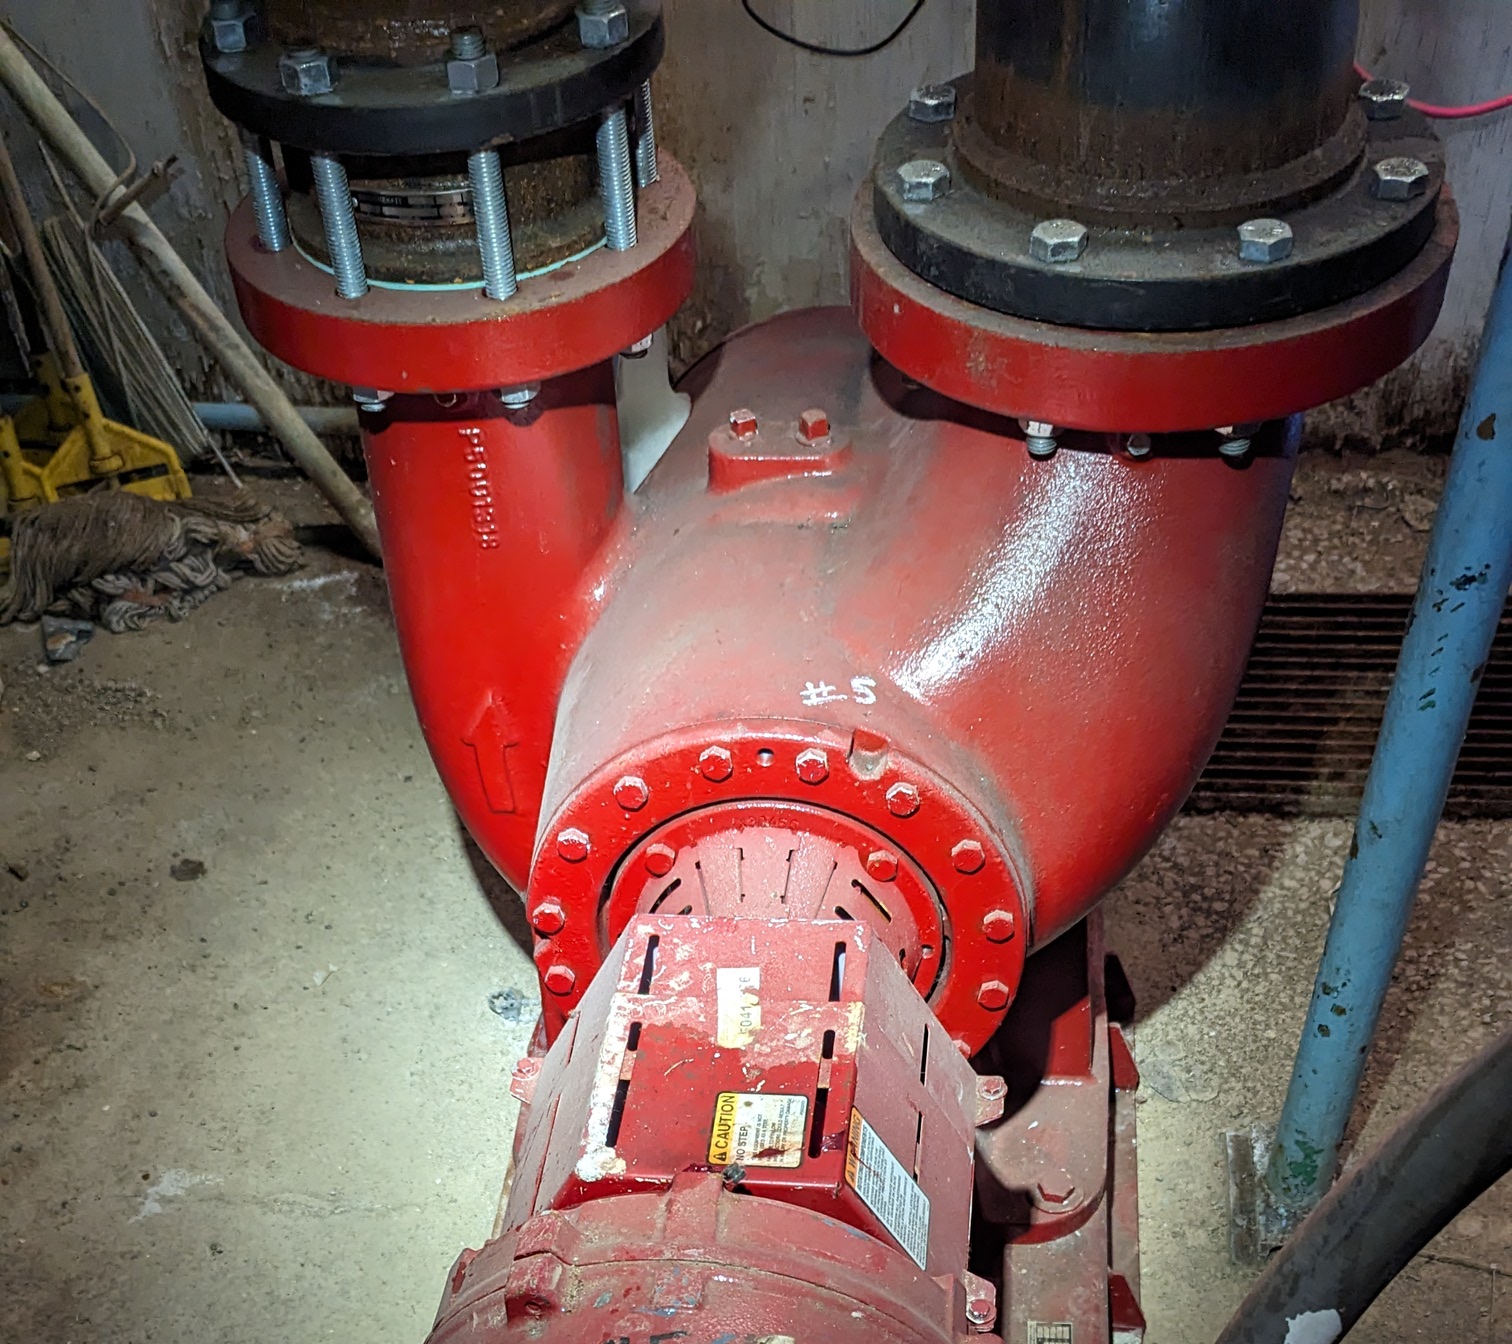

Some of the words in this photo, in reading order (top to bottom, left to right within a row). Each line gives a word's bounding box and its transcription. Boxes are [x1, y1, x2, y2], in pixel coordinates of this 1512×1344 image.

[715, 1095, 735, 1149] CAUTION
[737, 1126, 749, 1147] STEP
[735, 1149, 746, 1161] NO
